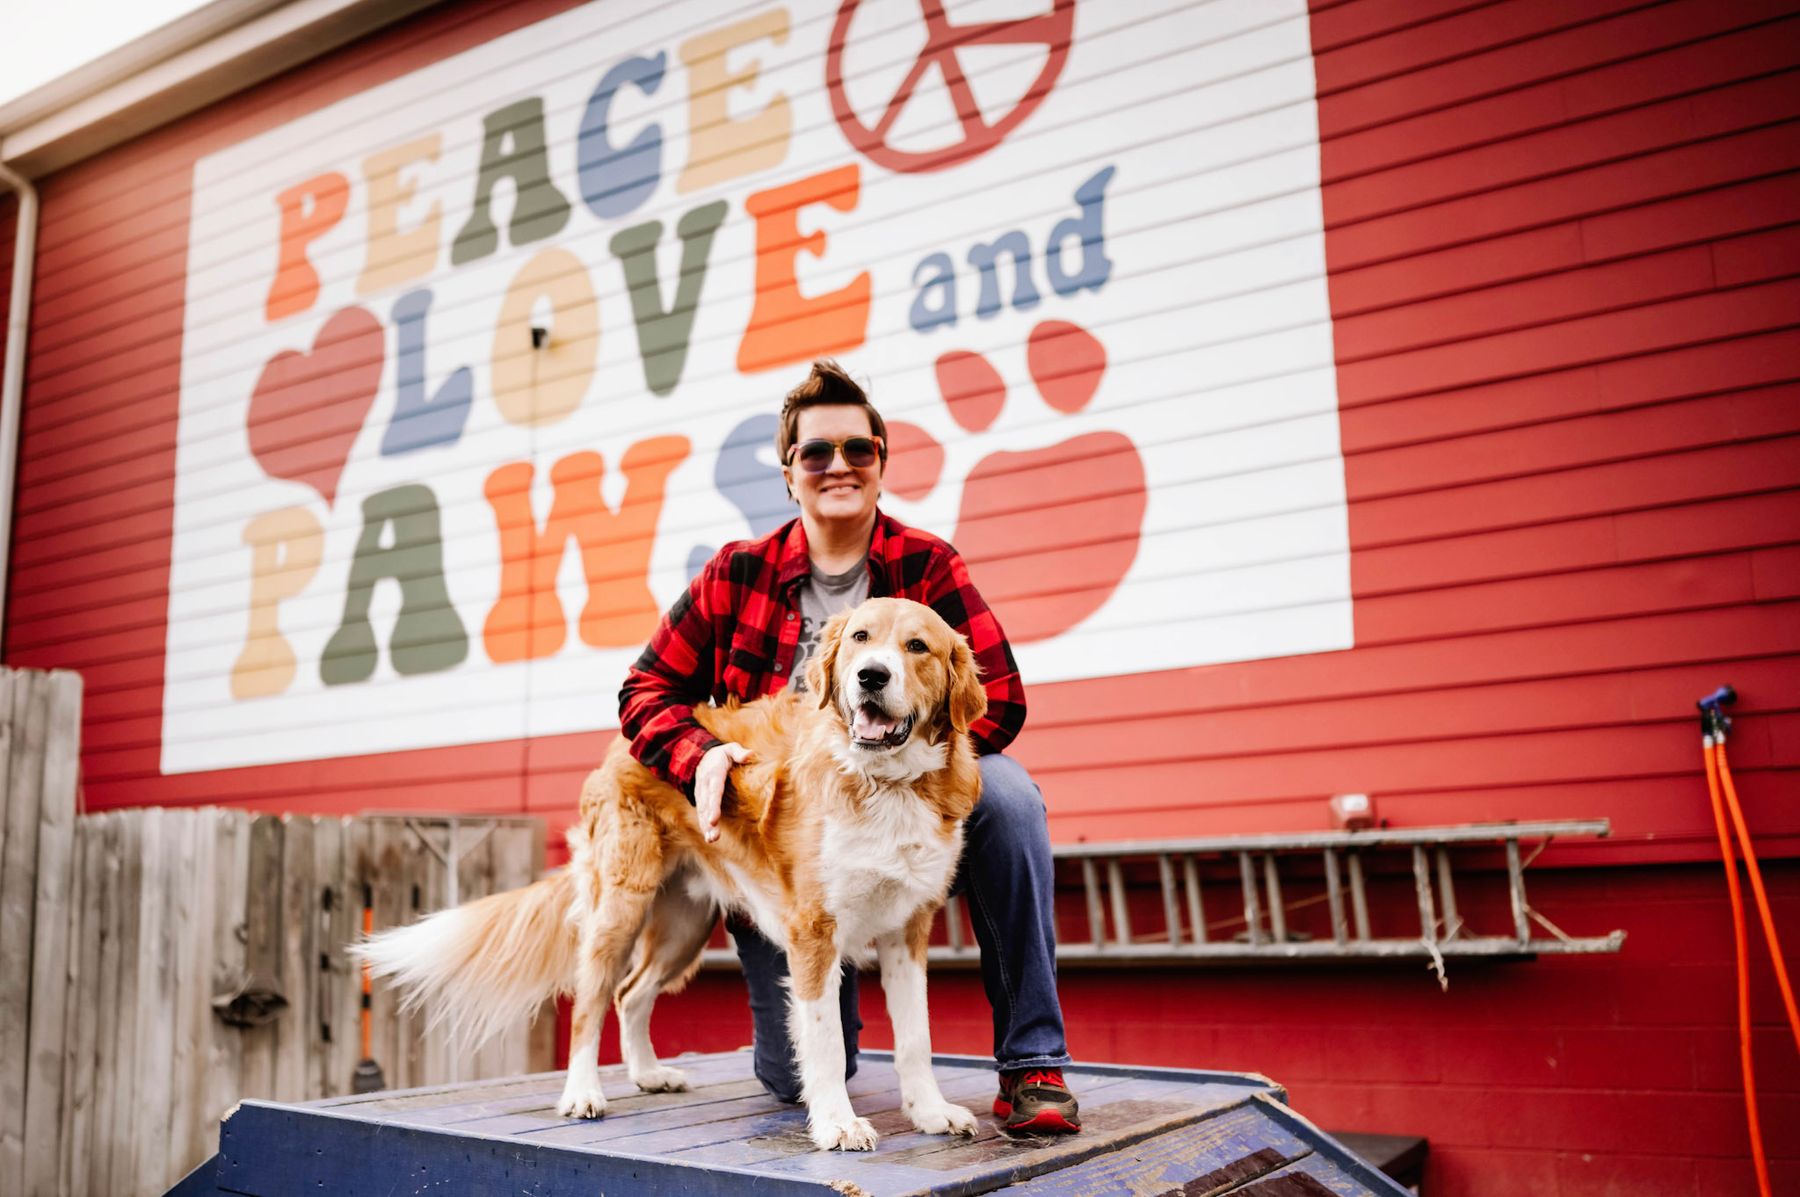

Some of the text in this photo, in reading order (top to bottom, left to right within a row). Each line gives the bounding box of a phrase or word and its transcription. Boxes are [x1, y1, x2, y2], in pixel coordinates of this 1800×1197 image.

[265, 7, 792, 322] PEACE
[380, 163, 1116, 457] LOVE and
